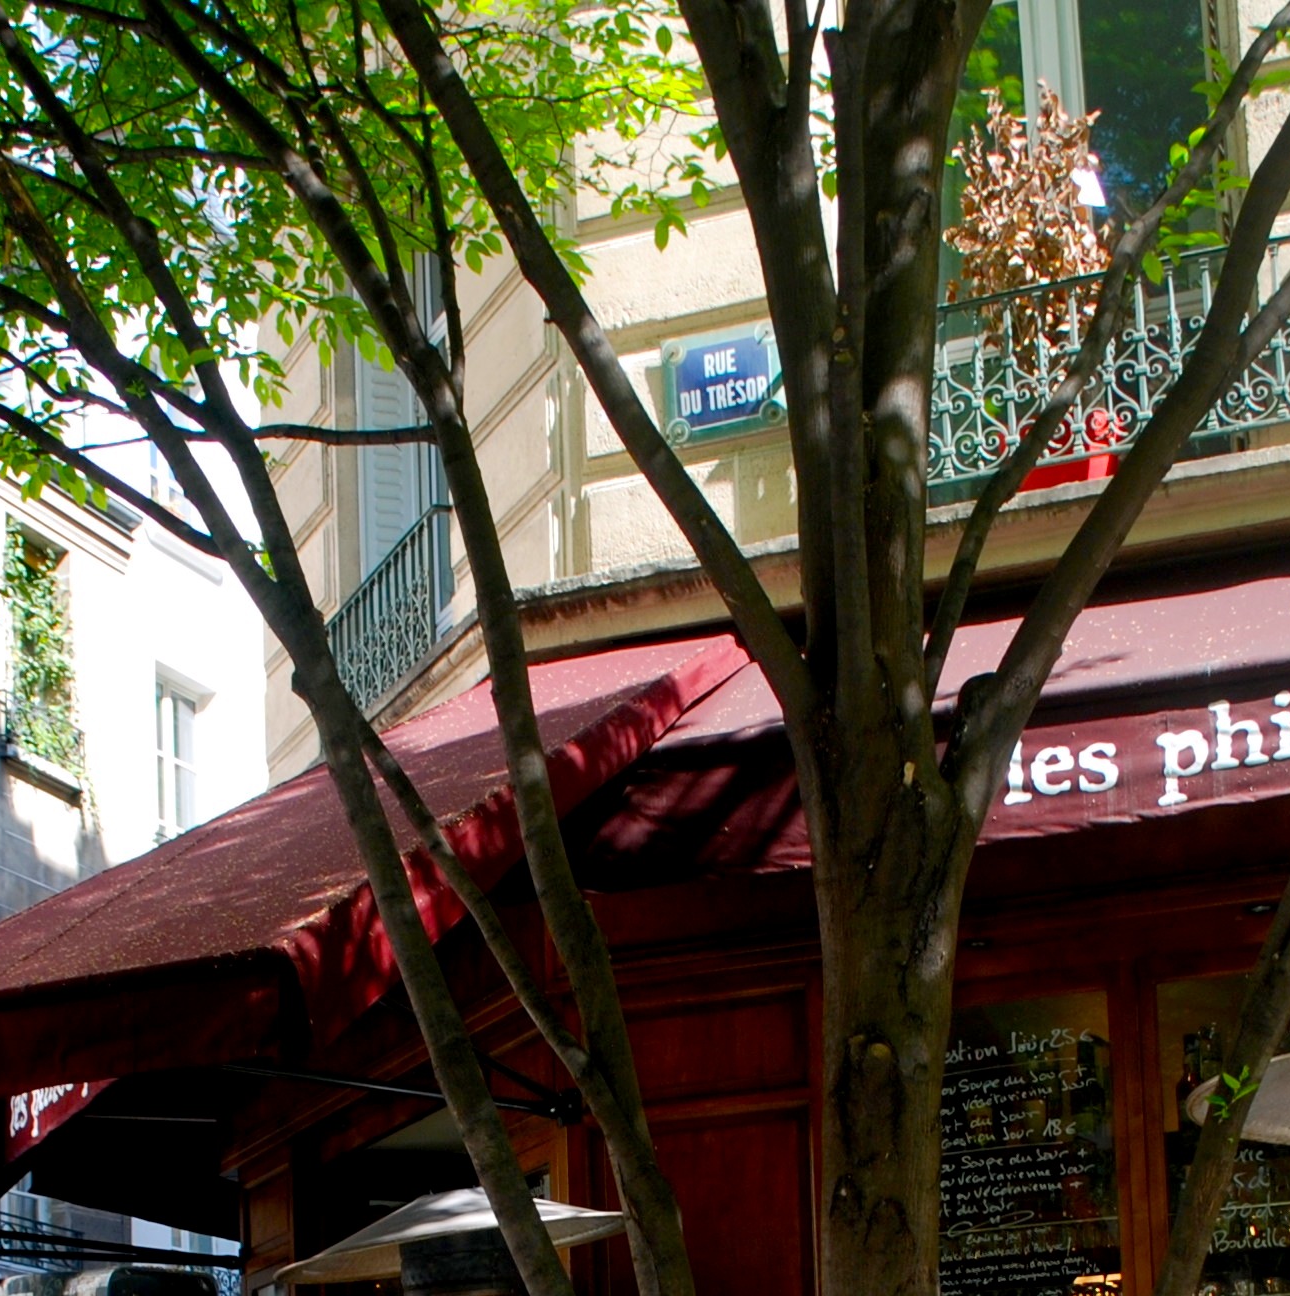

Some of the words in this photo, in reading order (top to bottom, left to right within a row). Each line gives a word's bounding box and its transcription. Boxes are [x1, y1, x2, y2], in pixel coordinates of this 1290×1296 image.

[703, 347, 737, 378] RUE
[679, 388, 702, 417] DU
[705, 374, 769, 411] TRÉSOR
[1004, 740, 1119, 804] les
[958, 1078, 1000, 1094] Soupe
[1003, 1074, 1026, 1086] du
[969, 1117, 993, 1129] du
[960, 1155, 1004, 1173] Soupe
[1009, 1153, 1033, 1166] du
